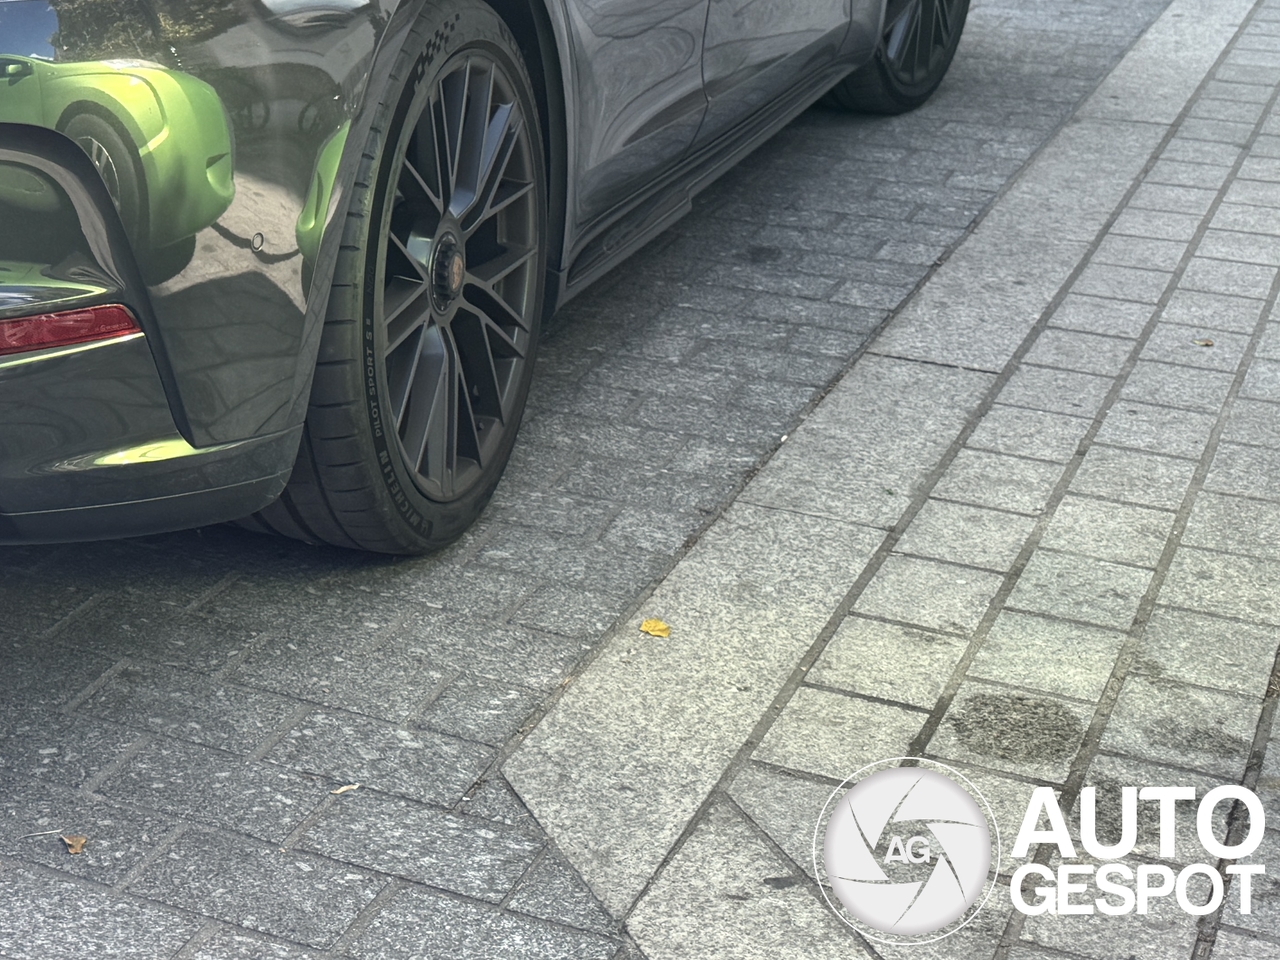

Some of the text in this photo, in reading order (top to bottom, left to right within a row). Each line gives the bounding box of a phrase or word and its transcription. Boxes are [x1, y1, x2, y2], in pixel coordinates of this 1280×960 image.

[366, 347, 376, 396] SPORT
[370, 400, 383, 437] PILOT
[379, 450, 420, 526] MICHELIN
